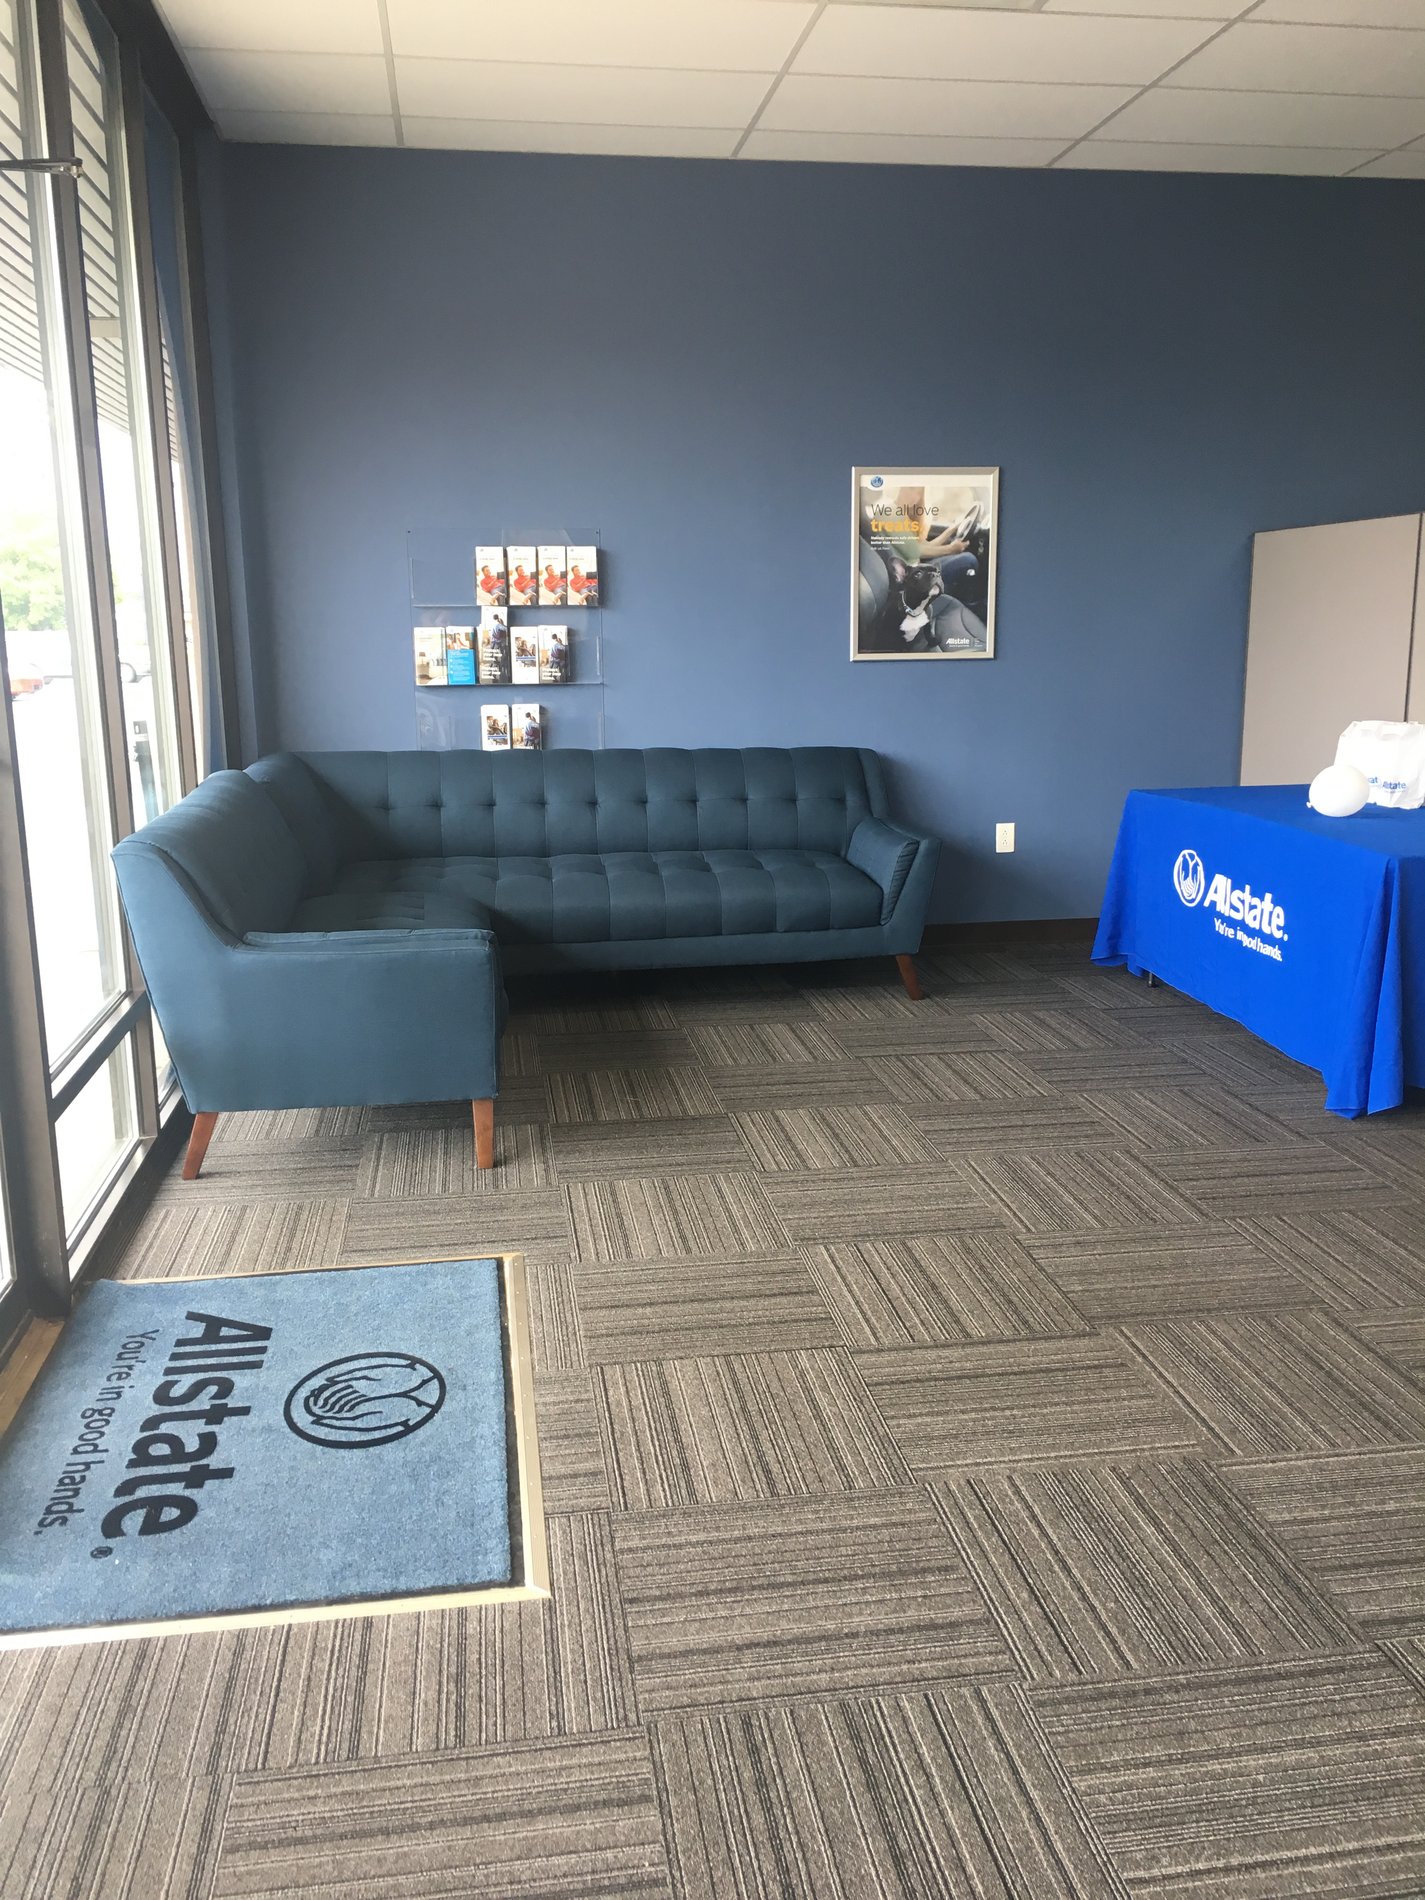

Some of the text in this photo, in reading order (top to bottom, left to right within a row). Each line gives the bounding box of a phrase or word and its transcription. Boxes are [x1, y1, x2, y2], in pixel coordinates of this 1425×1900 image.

[871, 503, 940, 516] We all love
[33, 1328, 160, 1536] You're in good hands.
[101, 1310, 274, 1540] Allstate
